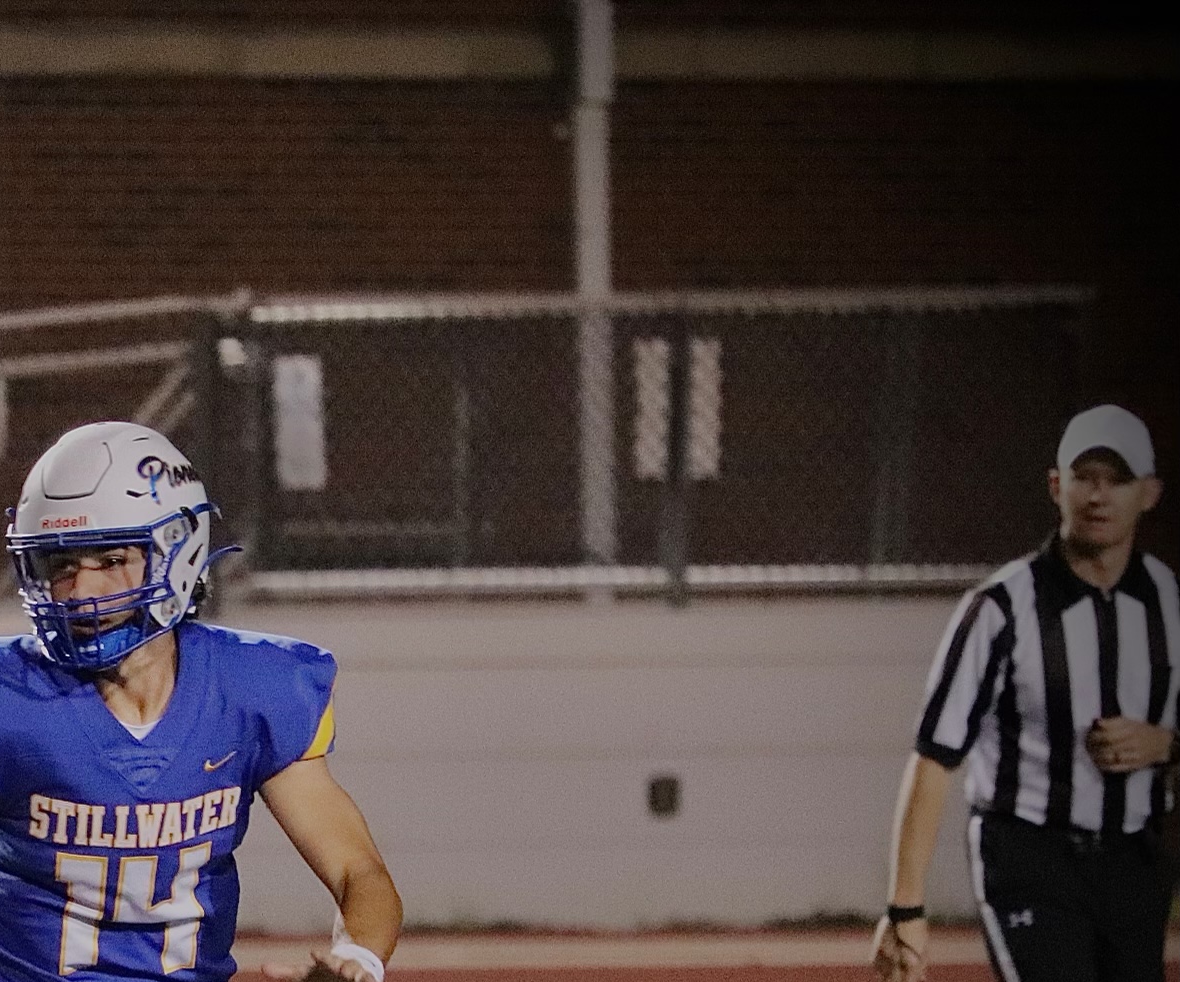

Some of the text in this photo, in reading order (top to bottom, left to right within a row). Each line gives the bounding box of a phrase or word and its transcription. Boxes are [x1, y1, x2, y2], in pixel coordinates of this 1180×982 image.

[41, 515, 87, 530] Riddell
[28, 785, 242, 849] STILLWATER
[54, 840, 213, 976] 14
